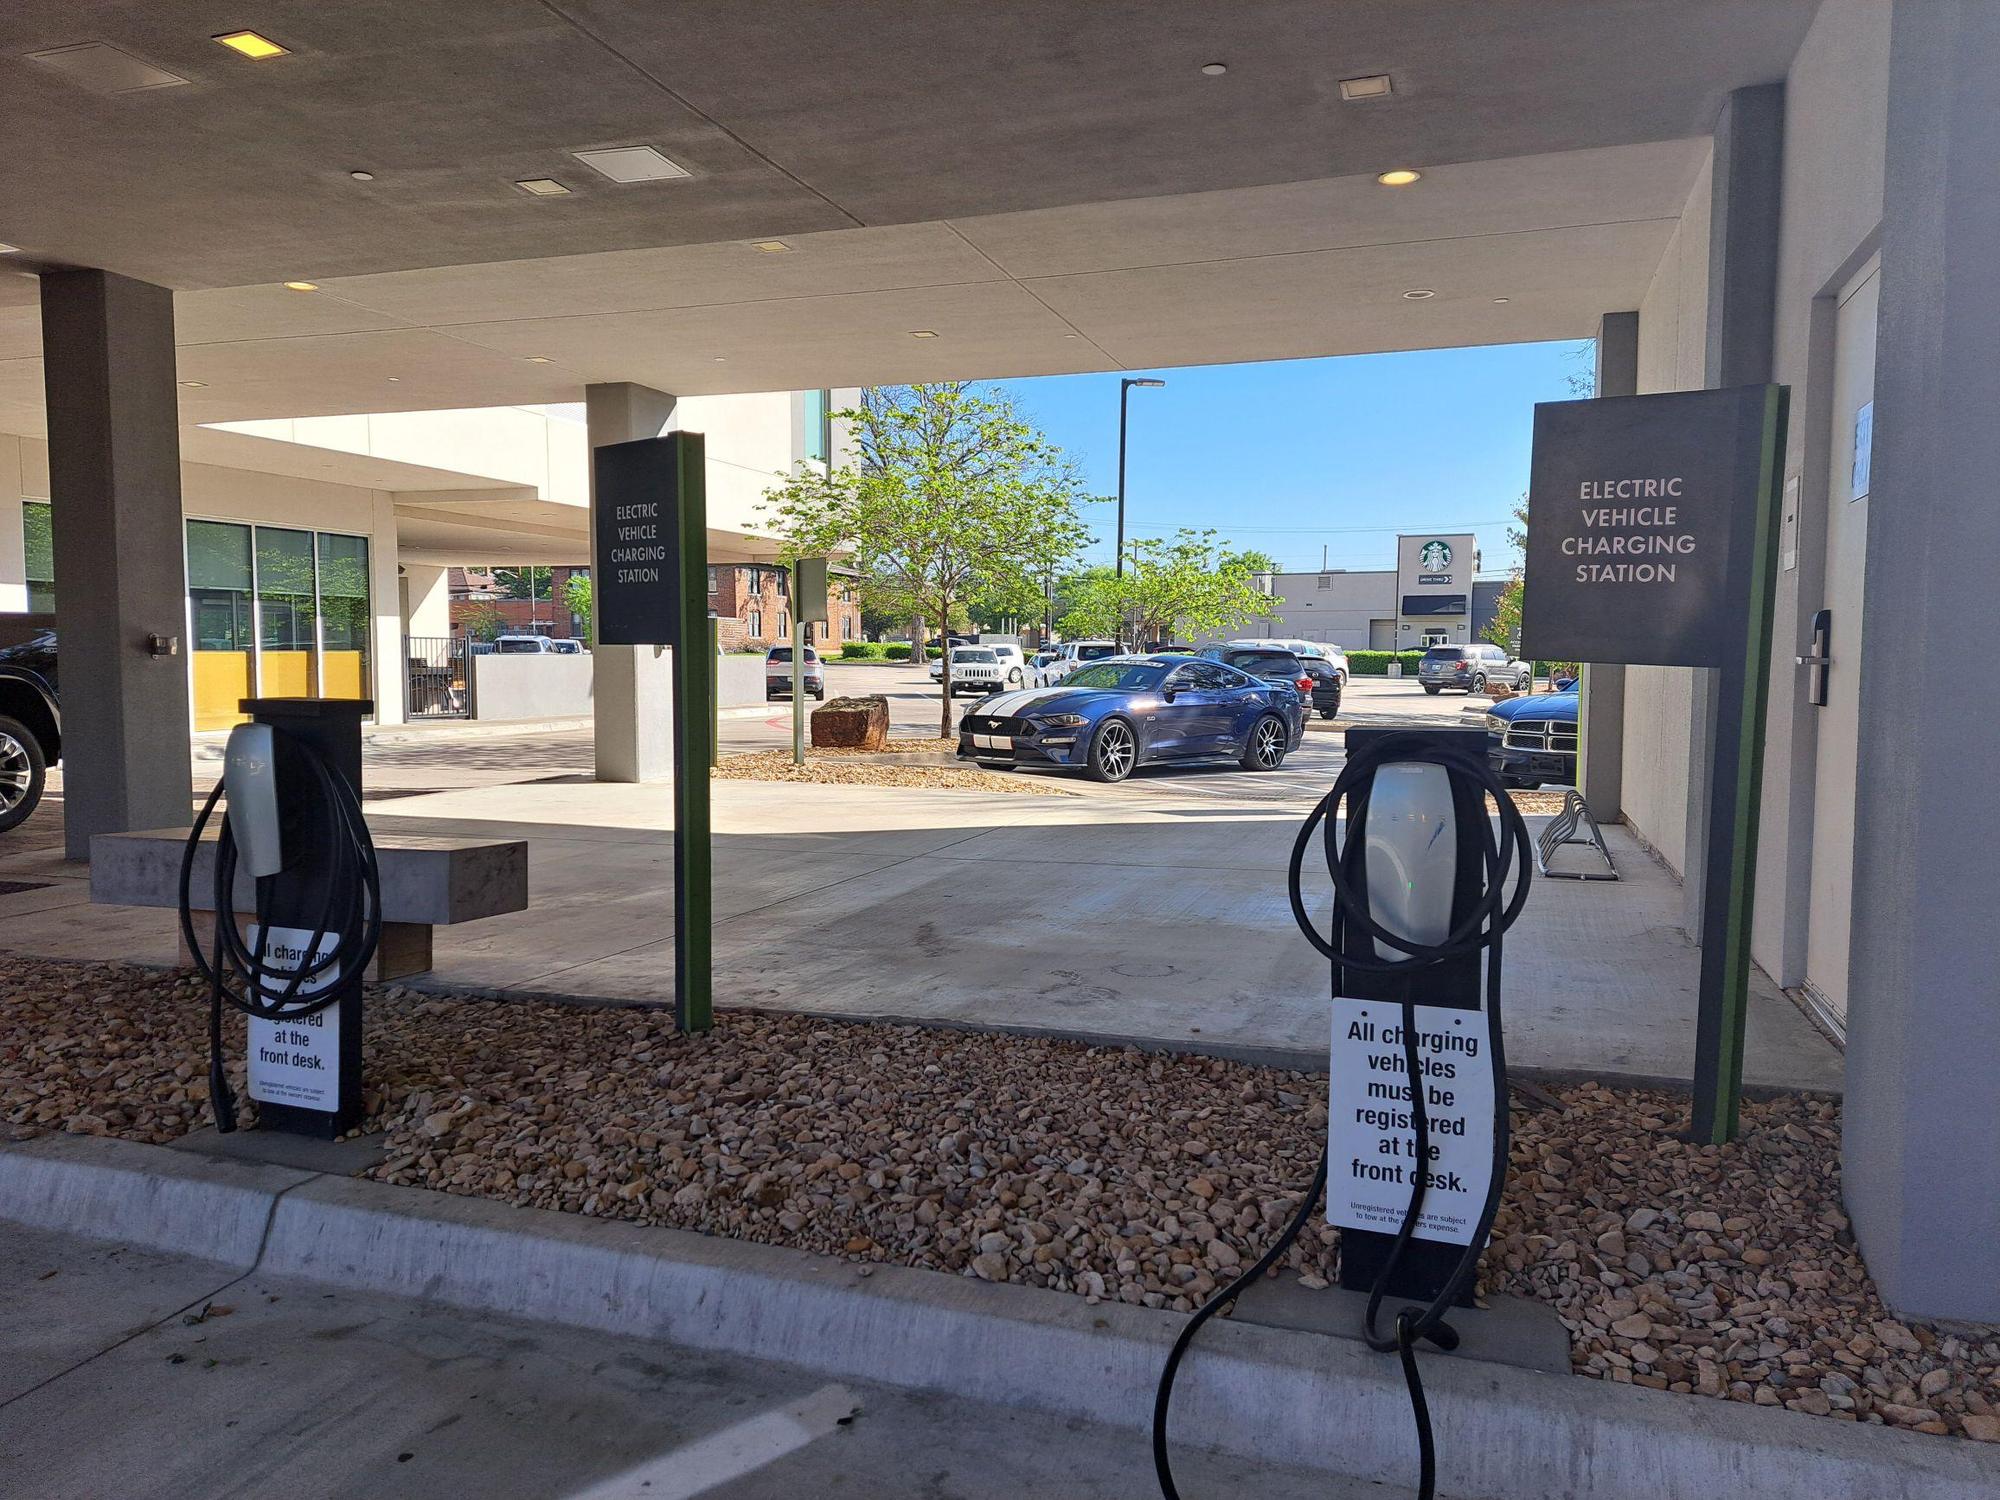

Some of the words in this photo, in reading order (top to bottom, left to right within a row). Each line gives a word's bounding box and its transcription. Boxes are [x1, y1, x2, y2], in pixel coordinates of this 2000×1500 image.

[1580, 477, 1683, 500] ELECTRIC
[616, 502, 658, 520] ELECTRIC
[1581, 506, 1677, 527] VEHICLE
[618, 524, 657, 541] VEHICLE
[611, 545, 666, 563] CHARGING
[1561, 534, 1696, 555] CHARGING
[618, 567, 659, 584] STATION
[1576, 563, 1677, 583] STATION
[274, 1030, 287, 1044] at
[290, 1030, 309, 1047] the
[1347, 1021, 1374, 1041] All
[1382, 1025, 1478, 1058] chrging
[260, 1046, 289, 1066] front
[292, 1052, 325, 1071] desk.
[1368, 1053, 1456, 1079] vehcles
[1368, 1082, 1416, 1102] mus
[1428, 1085, 1455, 1107] be
[1356, 1108, 1465, 1136] registred
[1378, 1137, 1400, 1156] at
[1406, 1139, 1441, 1161] te
[1352, 1158, 1403, 1184] front
[1350, 1200, 1395, 1216] Unregistered
[1427, 1213, 1439, 1222] are
[1440, 1215, 1466, 1225] subject
[1355, 1211, 1363, 1219] to
[1364, 1212, 1378, 1221] tow
